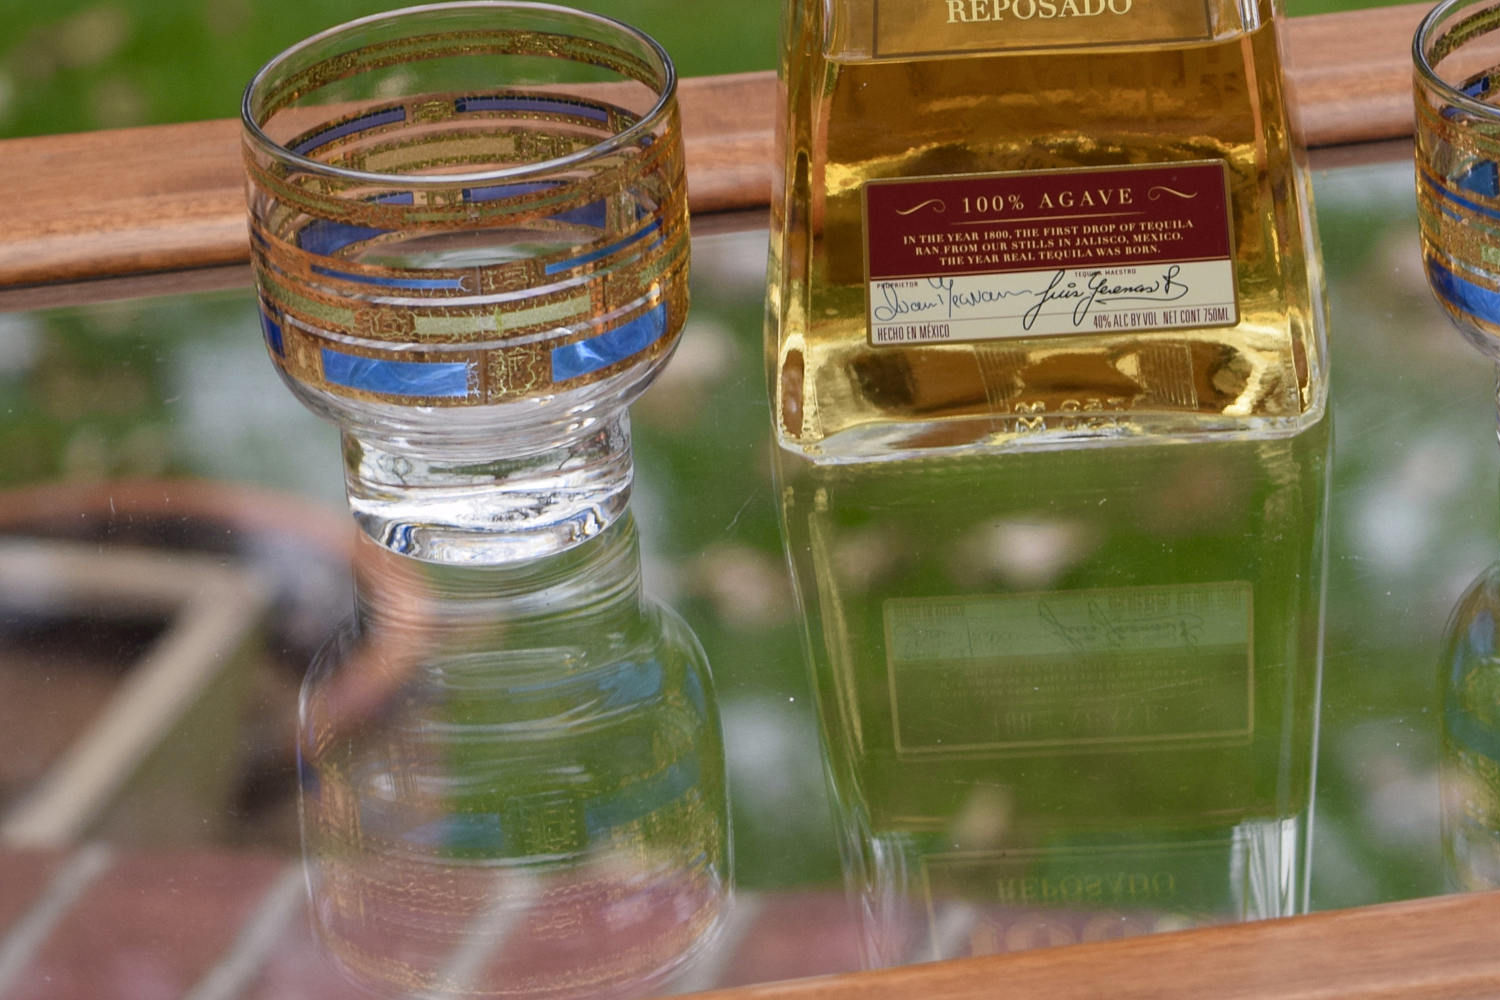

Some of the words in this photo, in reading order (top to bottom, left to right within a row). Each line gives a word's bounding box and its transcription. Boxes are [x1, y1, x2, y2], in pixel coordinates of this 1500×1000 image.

[962, 193, 1025, 214] 100%
[1038, 187, 1134, 210] AGAVE
[903, 235, 916, 245] IN
[920, 233, 944, 243] THE
[947, 232, 979, 242] YEAR
[1014, 228, 1039, 238] THE
[1043, 226, 1078, 236] FIRST
[1083, 224, 1116, 234] DROP
[1120, 223, 1136, 232] OF
[1139, 219, 1194, 231] TEQUILA
[915, 246, 939, 256] RAN
[944, 243, 978, 254] FROM
[982, 242, 1008, 252] OUR
[1011, 239, 1054, 250] STILLS
[1059, 238, 1071, 247] IN
[1075, 235, 1129, 246] JALISCO,
[1133, 231, 1183, 243] MEXICO.
[940, 256, 965, 266] THE
[967, 254, 999, 264] YEAR
[1003, 252, 1035, 262] REAL
[1039, 248, 1093, 260] TEQUILA
[1096, 246, 1121, 257] WAS
[1125, 244, 1161, 255] BORN.
[1093, 315, 1111, 329] 40%
[1113, 313, 1128, 327] ALC
[1130, 312, 1141, 326] BY
[1142, 311, 1158, 325] VOL
[1163, 310, 1177, 324] NET
[1180, 308, 1201, 323] CONT
[1204, 306, 1229, 322] 750ML
[877, 327, 903, 341] HECHO
[907, 325, 917, 339] EN
